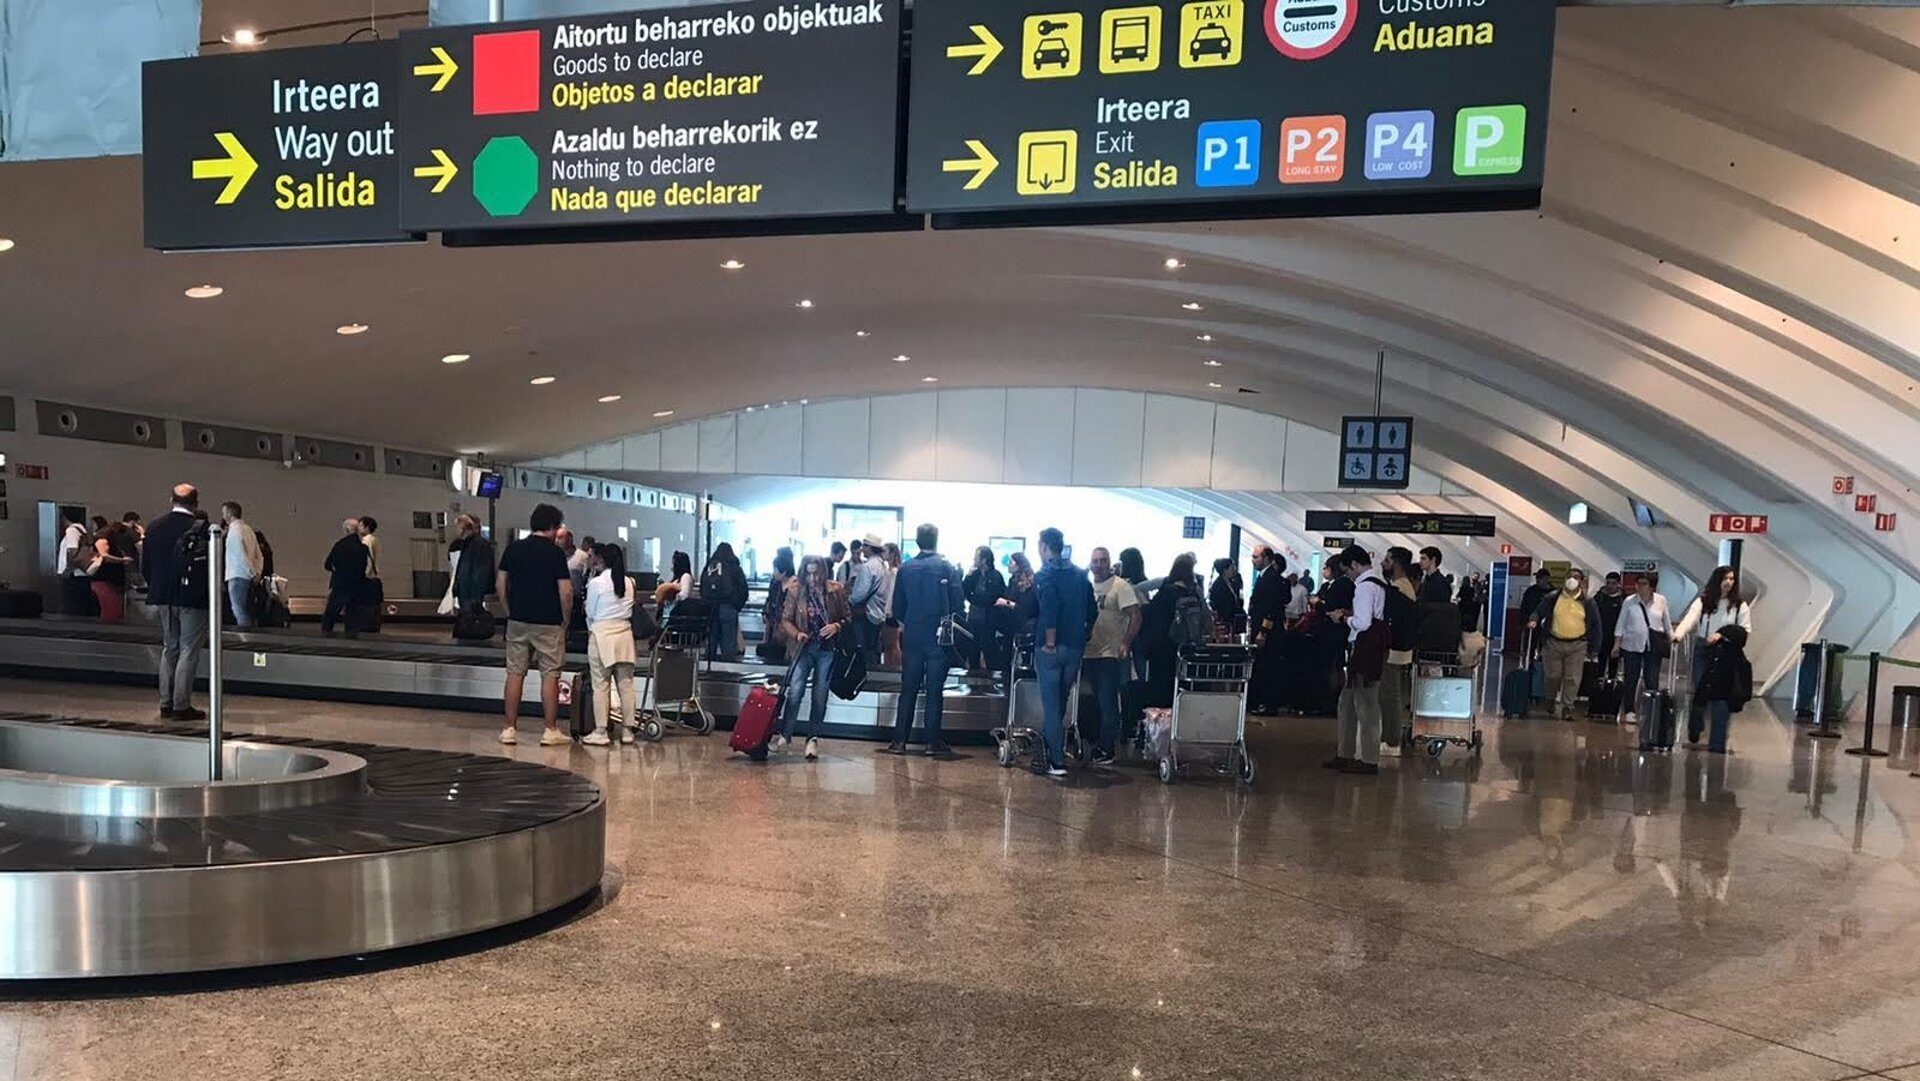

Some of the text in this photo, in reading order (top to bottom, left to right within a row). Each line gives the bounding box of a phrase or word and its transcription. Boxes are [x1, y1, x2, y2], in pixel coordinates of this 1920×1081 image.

[553, 1, 884, 49] Aitortu beharreko objektuak
[1193, 5, 1231, 20] TAXI
[1283, 20, 1337, 33] Customs
[1373, 22, 1494, 52] Aduana
[553, 46, 704, 76] Goods to declare
[272, 79, 380, 113] Irteera
[552, 72, 764, 110] Objetos a declarar
[1097, 97, 1190, 123] Irteera
[275, 121, 395, 166] Way out
[552, 117, 819, 154] Azaldu beharrekorik ez
[1096, 130, 1134, 154] Exit
[1286, 127, 1340, 163] P2
[1373, 122, 1428, 158] P4
[1464, 115, 1504, 167] P
[552, 153, 716, 181] Nothing to declare
[1204, 136, 1252, 171] P1
[1372, 160, 1423, 172] LOW COST
[1094, 160, 1178, 189] Salida
[1285, 164, 1337, 176] LONG STAY
[274, 171, 375, 210] Salida
[551, 181, 763, 213] Nada que declarar
